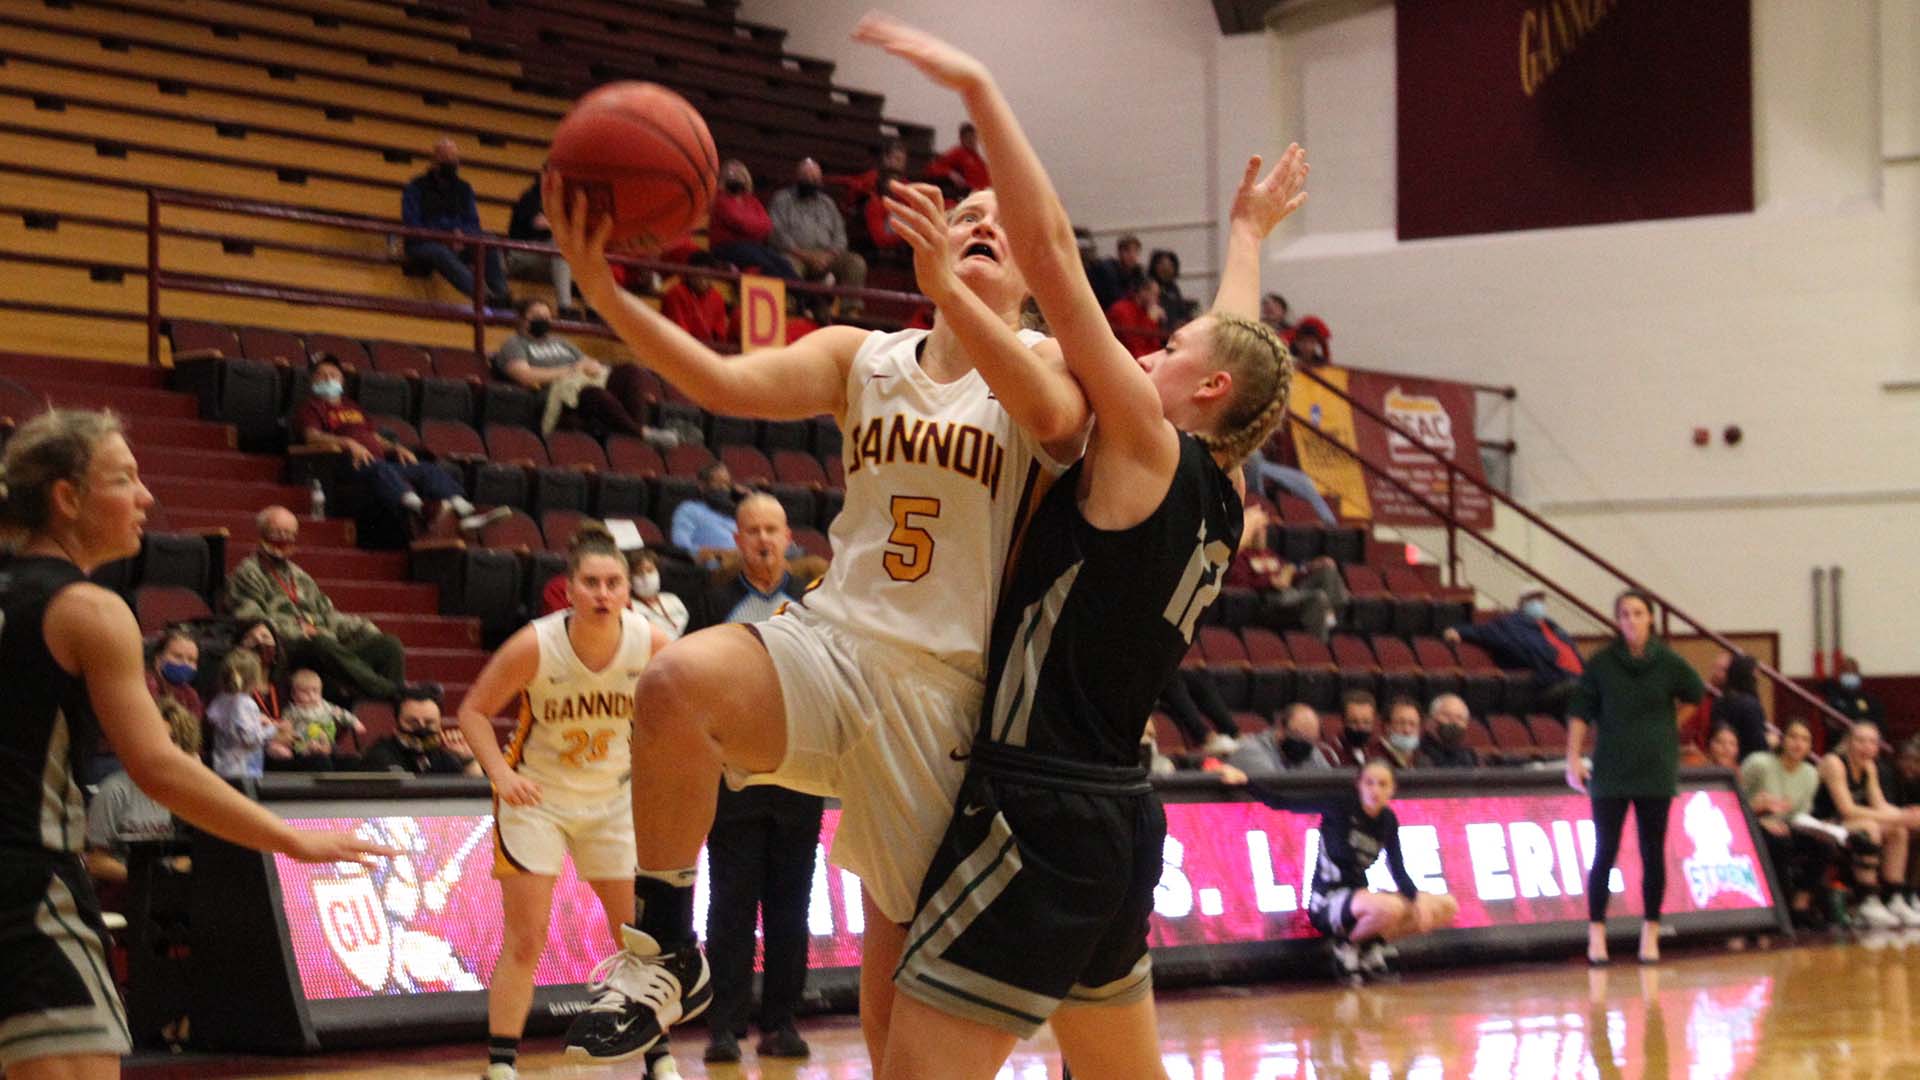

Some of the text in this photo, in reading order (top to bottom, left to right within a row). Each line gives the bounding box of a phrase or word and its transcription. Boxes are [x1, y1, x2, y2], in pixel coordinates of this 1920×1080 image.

[1519, 0, 1617, 96] GANNO
[749, 287, 779, 346] D
[883, 495, 941, 583] 5
[326, 895, 382, 951] GU
